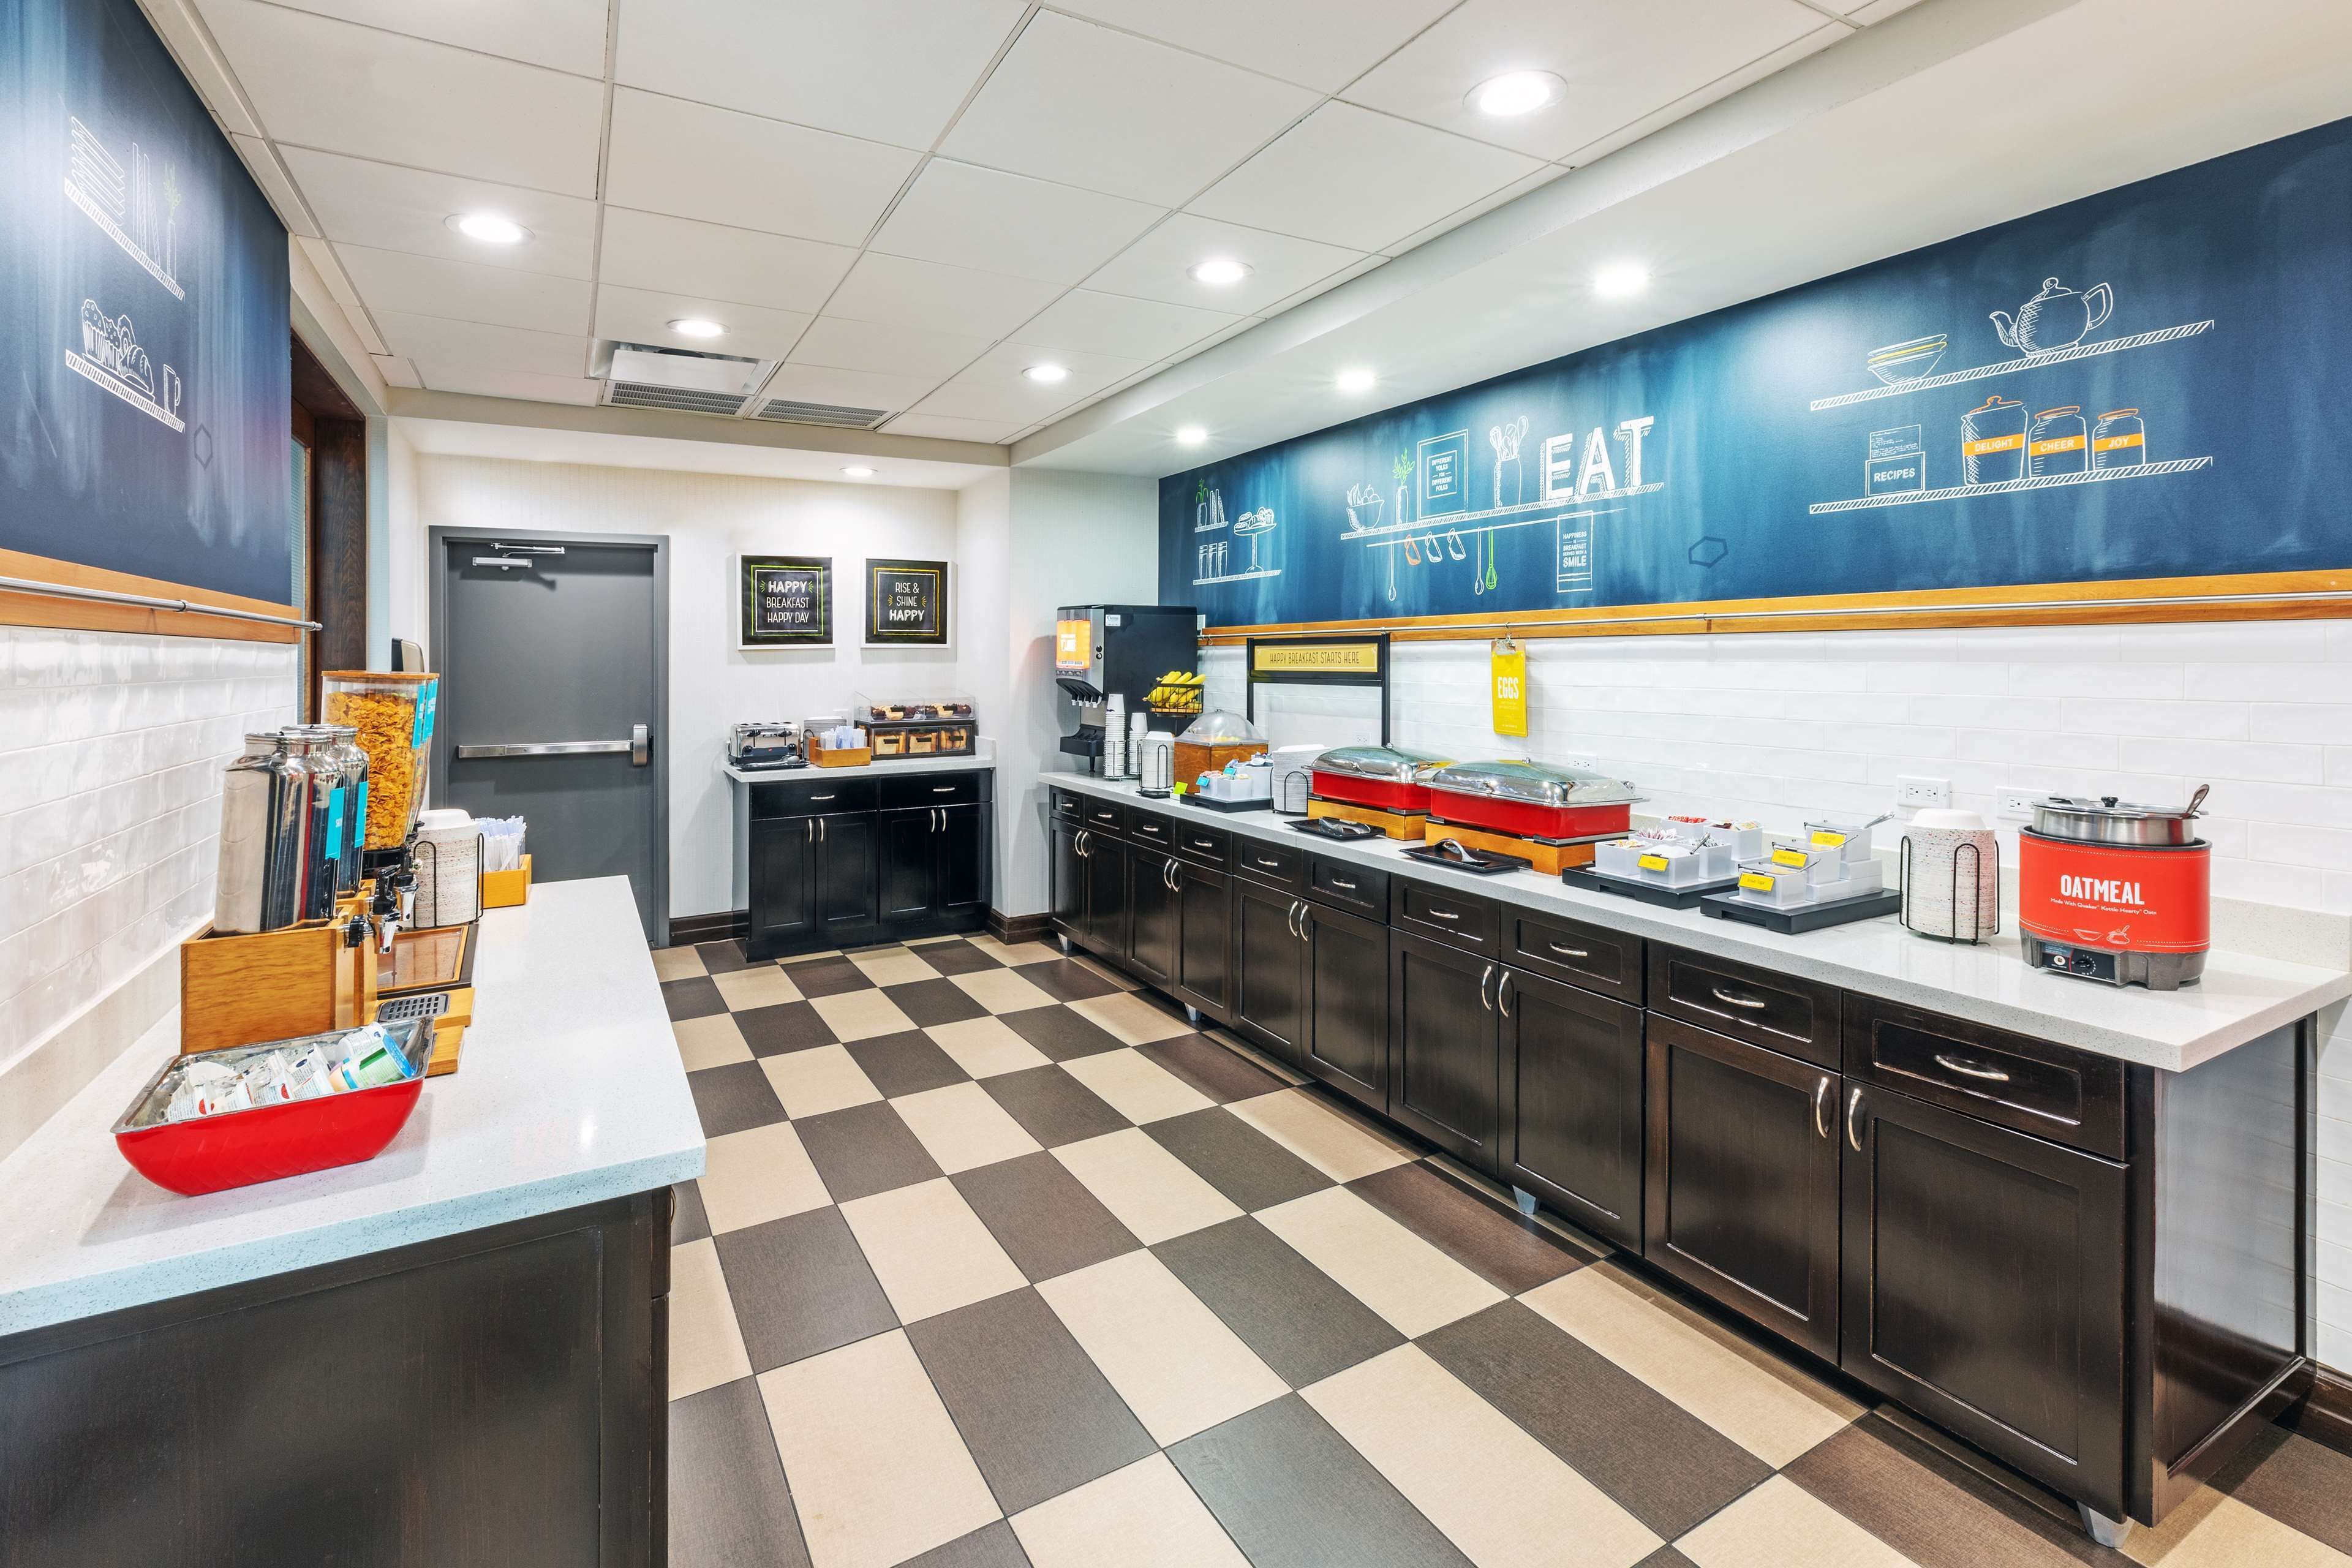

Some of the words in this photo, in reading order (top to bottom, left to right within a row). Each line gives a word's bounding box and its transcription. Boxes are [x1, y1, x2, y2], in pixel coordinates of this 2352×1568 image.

[1974, 439, 2014, 452] DELIGHT
[2040, 439, 2075, 452] CHEER
[2108, 437, 2130, 448] JOY
[1431, 456, 1452, 466] DIFFERENT
[1541, 416, 1654, 500] EAT
[1431, 476, 1452, 486] DIFFERENT
[1874, 468, 1915, 482] RECIPES
[1563, 555, 1586, 568] SMILE
[768, 581, 807, 593] HAPPY
[895, 582, 911, 593] RISE
[913, 582, 919, 594] &
[766, 597, 810, 608] BREAKFAST
[896, 595, 918, 606] SHINE
[767, 612, 793, 623] HAPPY
[795, 612, 809, 623] DAY
[889, 609, 925, 622] HAPPY
[1270, 653, 1286, 664] HAPPY
[1288, 652, 1319, 664] BREAKFAST
[1321, 652, 1341, 664] STARTS
[1344, 651, 1360, 664] HERE
[1498, 676, 1519, 699] EGGS
[2060, 875, 2145, 905] OATMEAL
